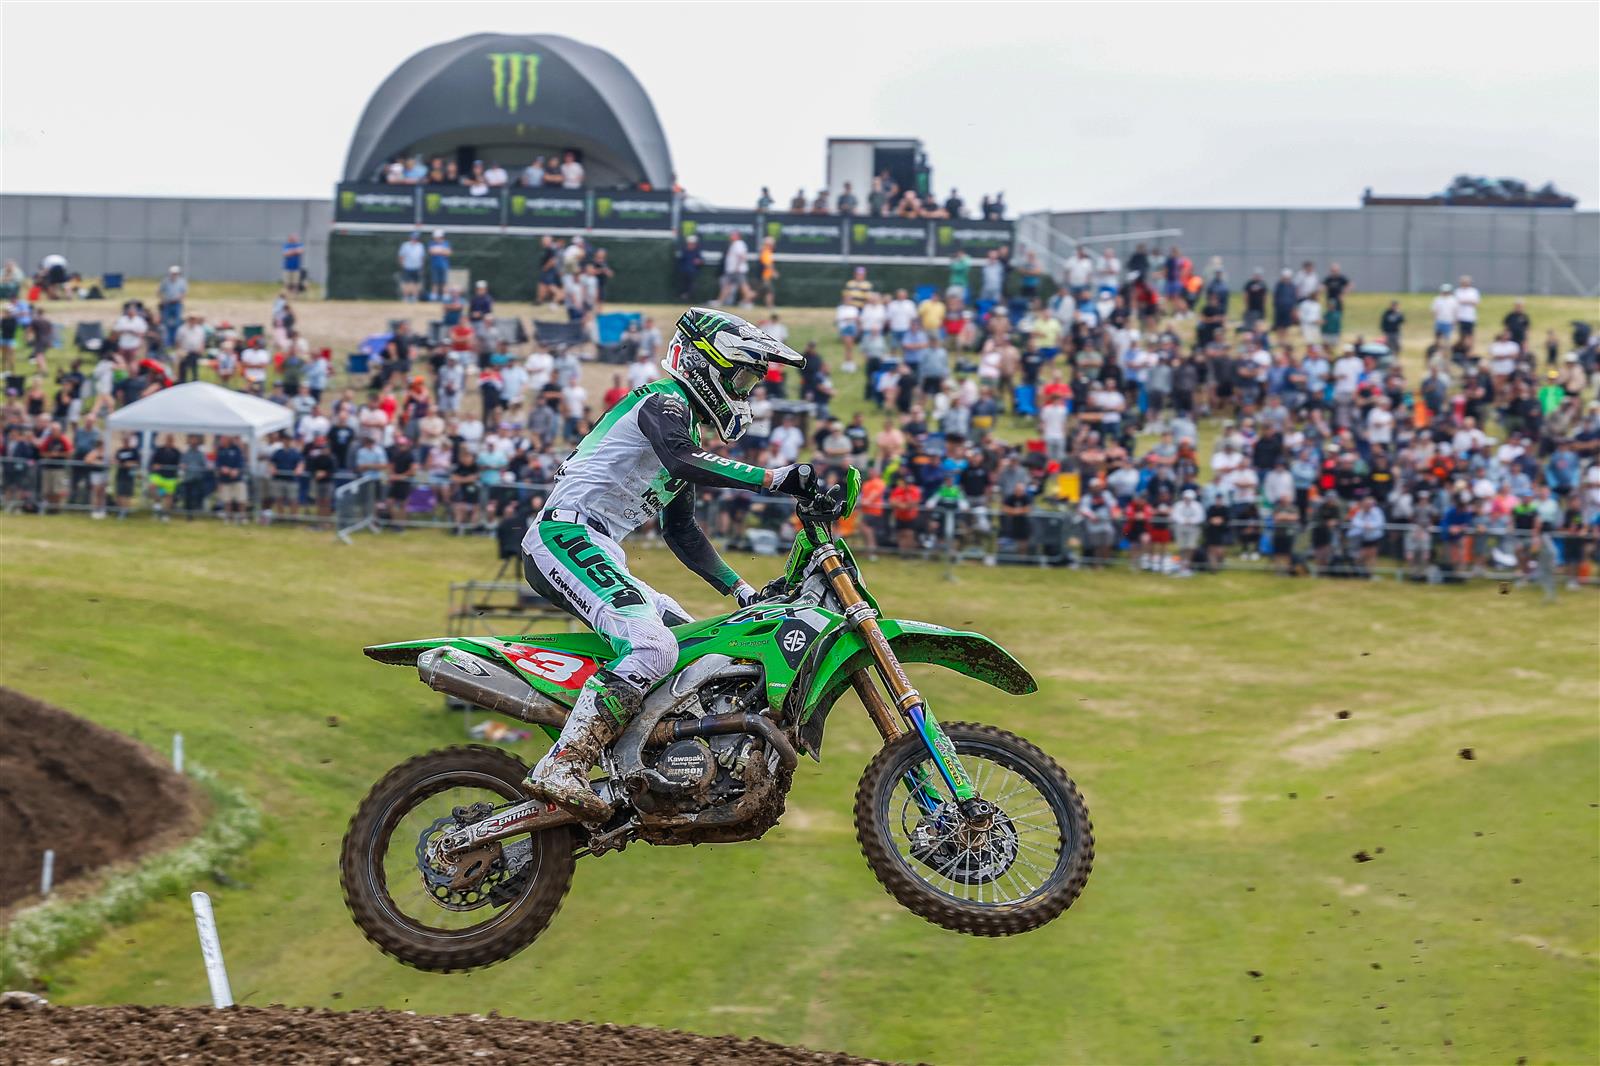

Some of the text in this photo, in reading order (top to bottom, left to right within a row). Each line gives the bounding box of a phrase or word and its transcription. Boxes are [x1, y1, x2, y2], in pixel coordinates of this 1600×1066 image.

[692, 369, 718, 406] MONSTER
[549, 567, 592, 615] Kawasaki
[516, 652, 584, 682] 3
[667, 753, 704, 762] Kawasaki
